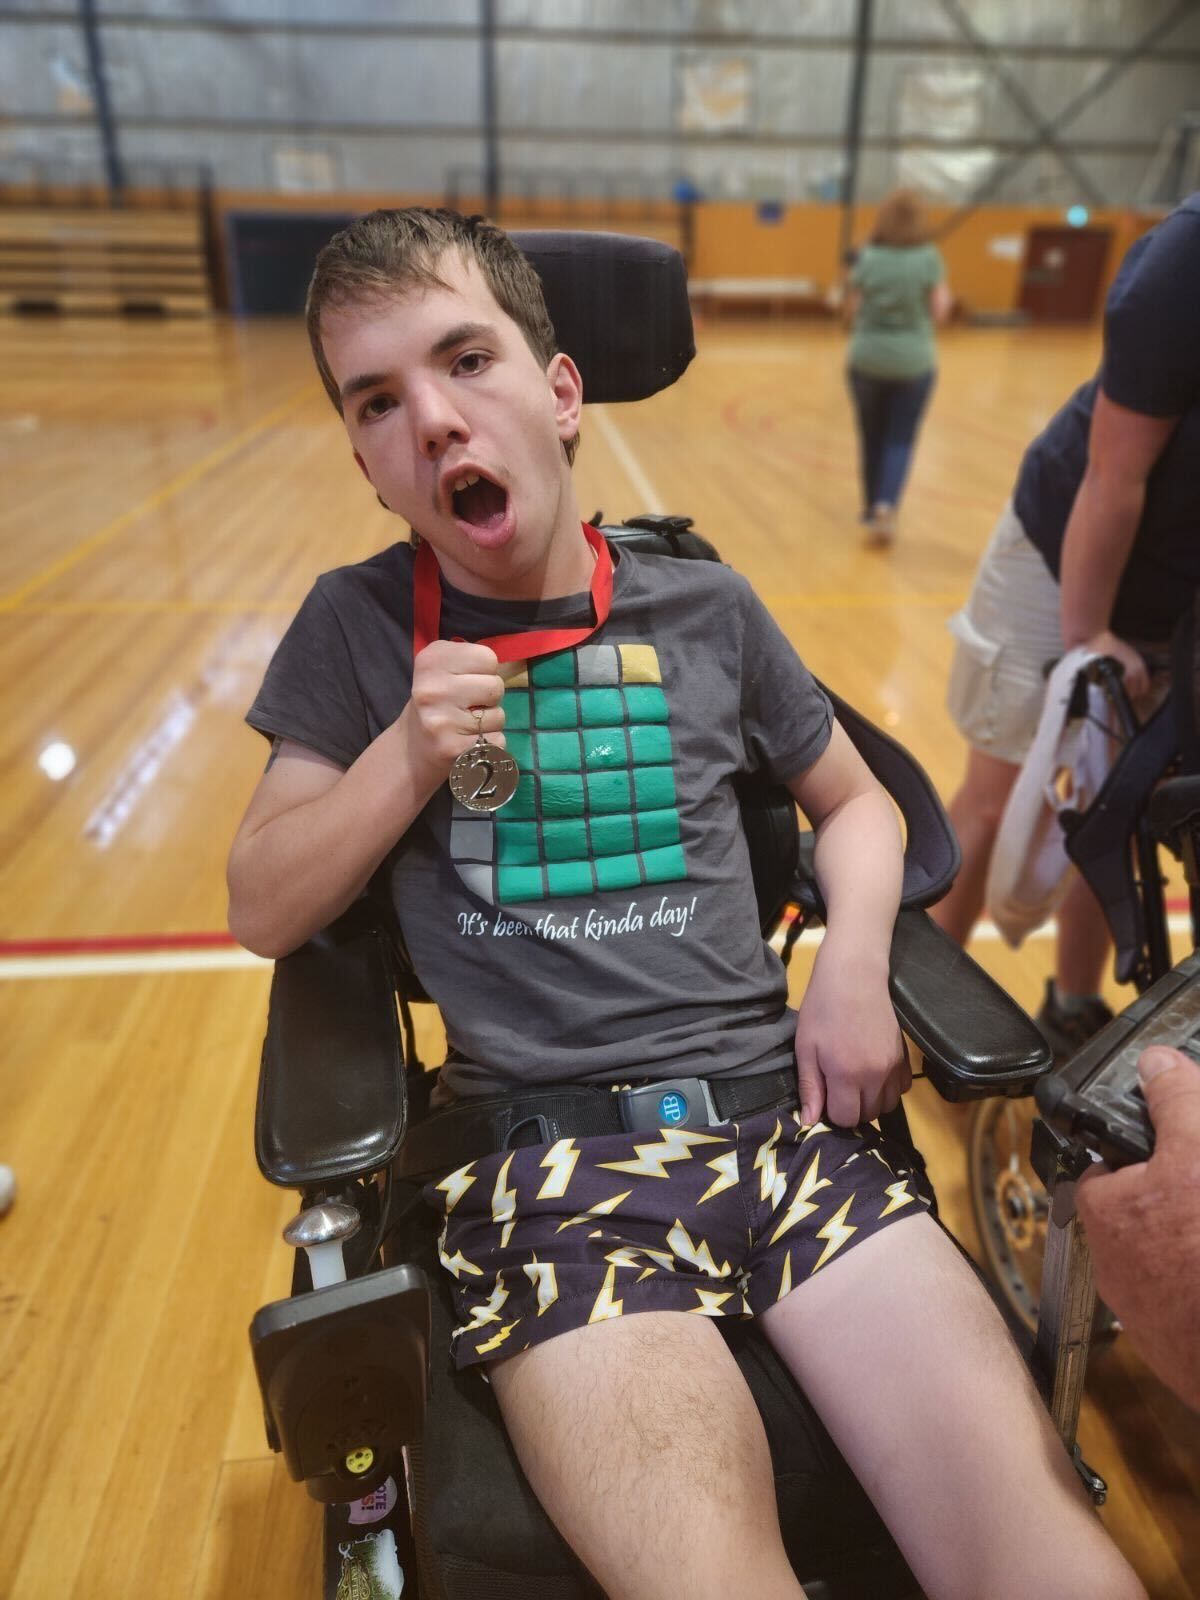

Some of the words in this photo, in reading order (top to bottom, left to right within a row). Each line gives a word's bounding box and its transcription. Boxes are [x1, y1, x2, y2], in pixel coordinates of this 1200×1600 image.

[457, 912, 489, 936] It's
[492, 911, 533, 937] been
[534, 913, 580, 940] that
[584, 901, 644, 941] kinda
[649, 896, 697, 937] day!
[375, 1484, 387, 1510] OTE
